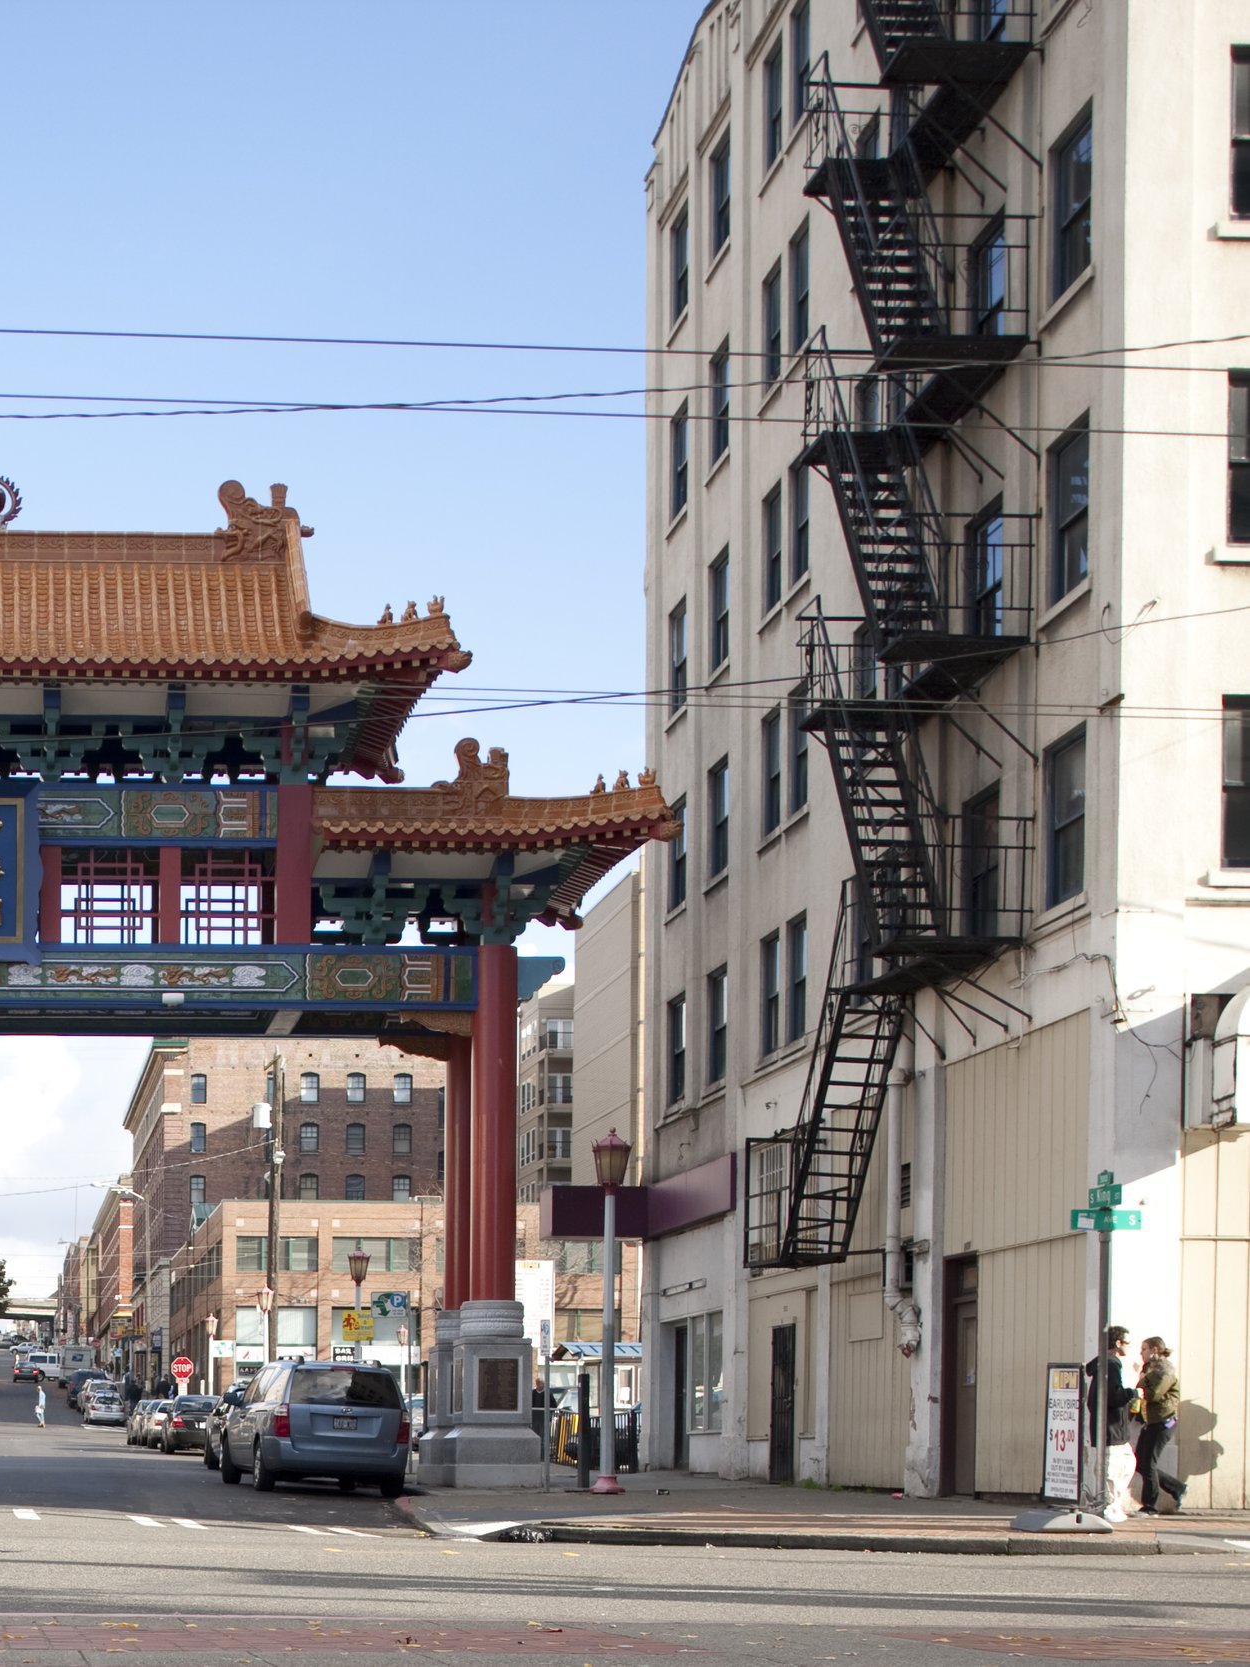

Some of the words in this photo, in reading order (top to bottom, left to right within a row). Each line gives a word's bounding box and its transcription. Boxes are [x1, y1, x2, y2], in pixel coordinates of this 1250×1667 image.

[1089, 1193, 1095, 1204] S
[1096, 1189, 1111, 1205] King
[1128, 1214, 1137, 1226] S
[393, 1295, 402, 1307] P
[335, 1347, 352, 1355] BAR
[173, 1363, 192, 1373] STOP
[1052, 1409, 1076, 1422] SPECIAL
